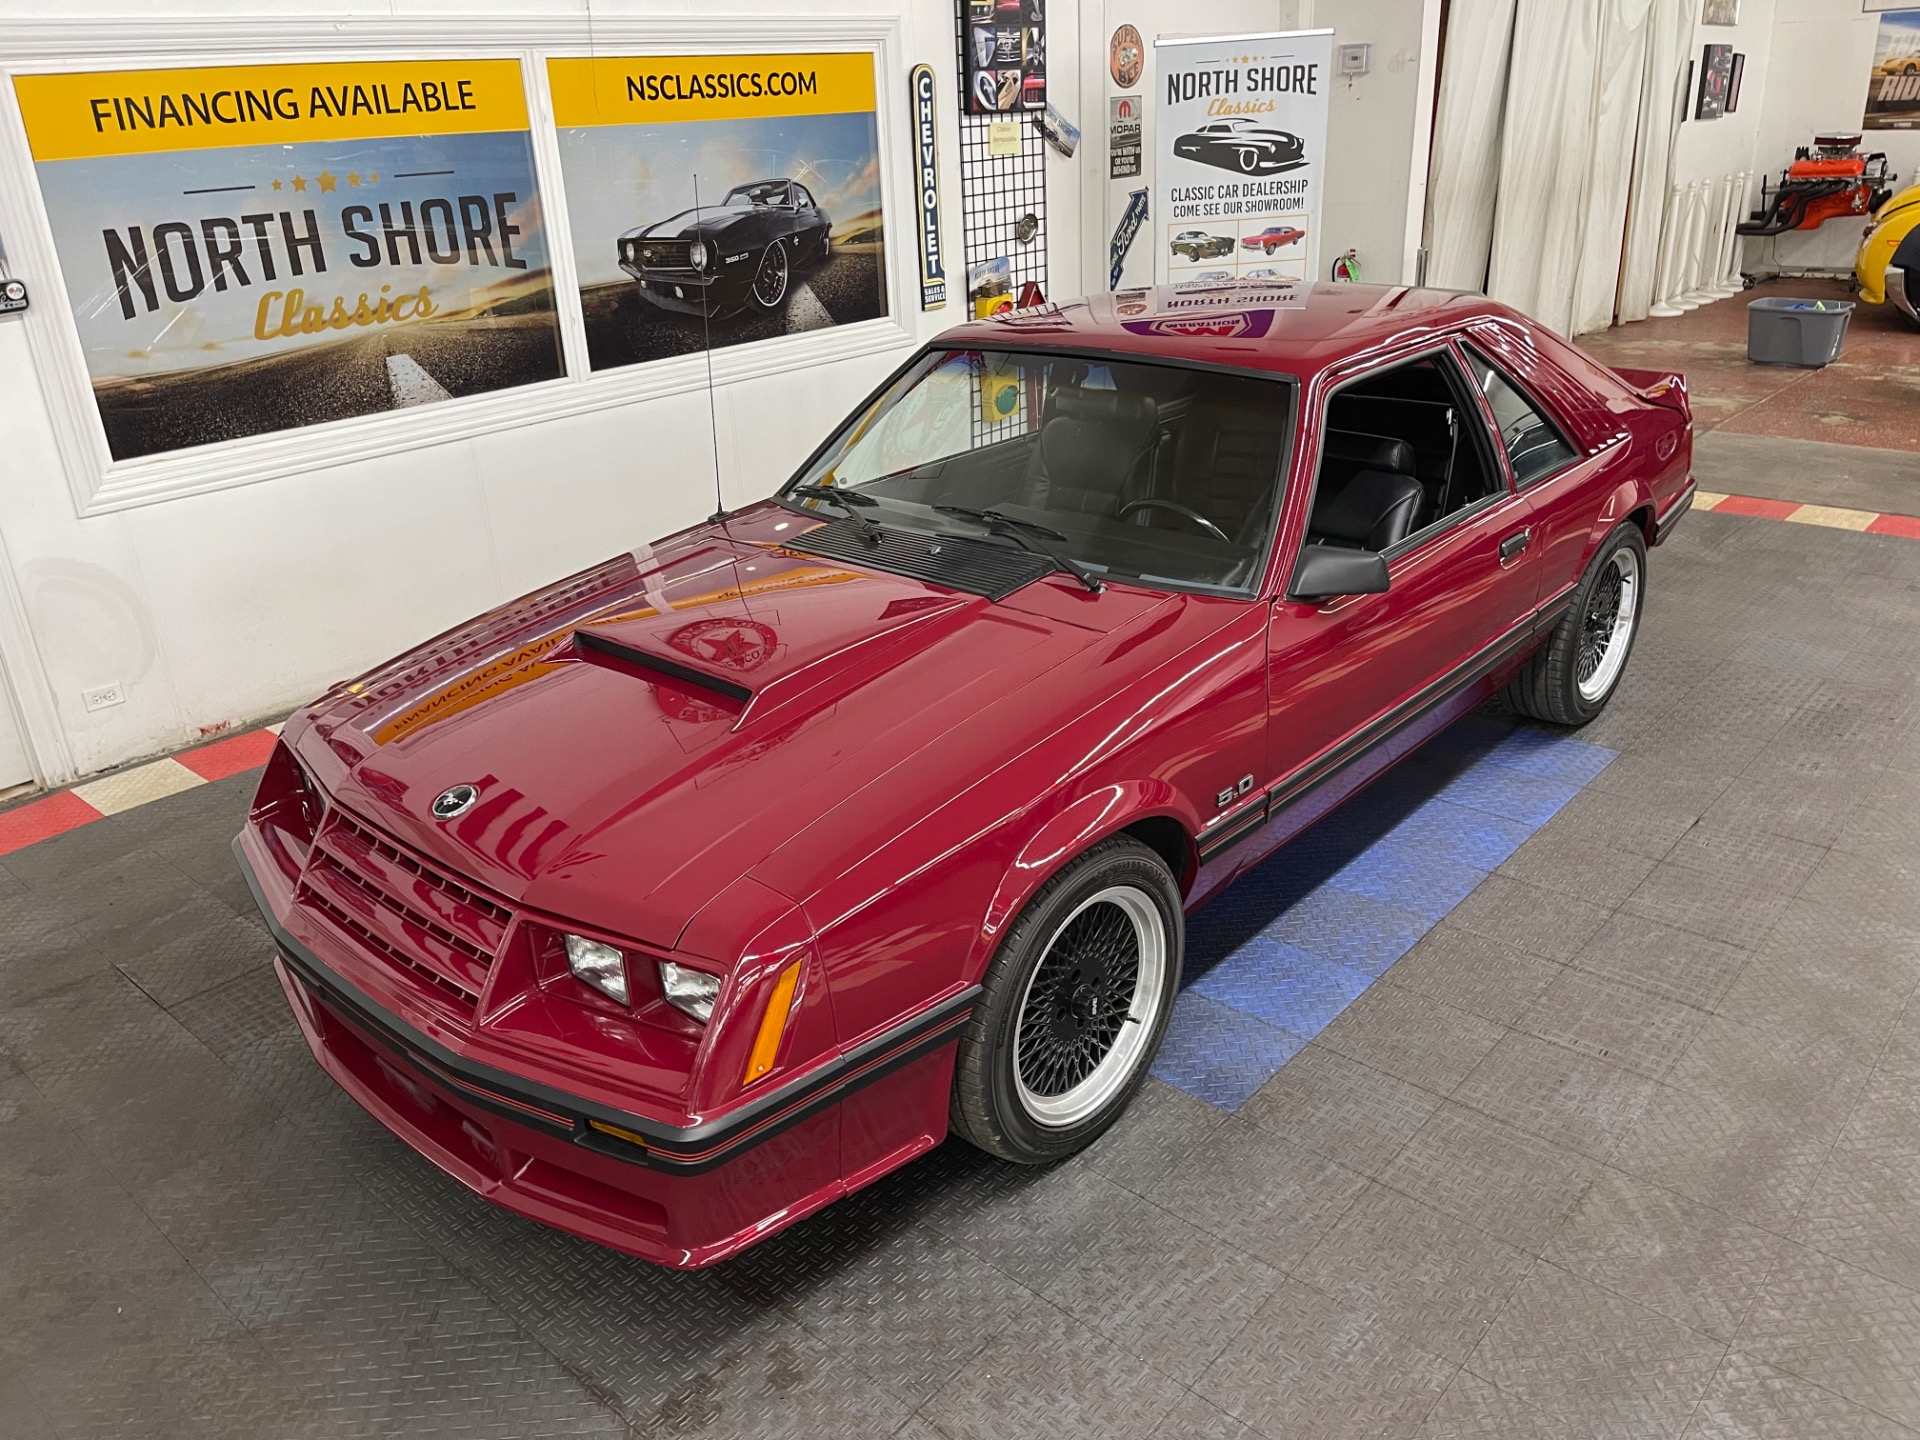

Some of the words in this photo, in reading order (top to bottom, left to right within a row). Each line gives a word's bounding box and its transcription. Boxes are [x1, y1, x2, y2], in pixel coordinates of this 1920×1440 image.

[626, 71, 817, 102] NSCLASSICS.COM
[1118, 61, 1139, 84] BEE
[1168, 69, 1239, 105] NORTH
[1247, 64, 1318, 95] SHORE
[1877, 75, 1920, 101] RID
[90, 87, 299, 133] FINANCING
[308, 80, 476, 118] AVAILABLE
[1207, 97, 1276, 116] Classics
[918, 77, 938, 274] CHEVROLET
[1171, 185, 1215, 202] CLASSIC
[1218, 183, 1239, 199] CAR
[1242, 179, 1309, 197] DEALERSHIP
[1173, 203, 1201, 218] COME
[1203, 202, 1221, 216] SEE
[1223, 201, 1243, 214] OUR
[1245, 197, 1305, 213] SHOWROOM!
[1116, 212, 1138, 256] Ford
[102, 208, 328, 321] NORTH
[341, 191, 528, 270] SHORE
[924, 286, 941, 296] SALES
[924, 293, 946, 303] SERVICE
[253, 284, 440, 341] Classics
[1217, 773, 1254, 808] 5.0
